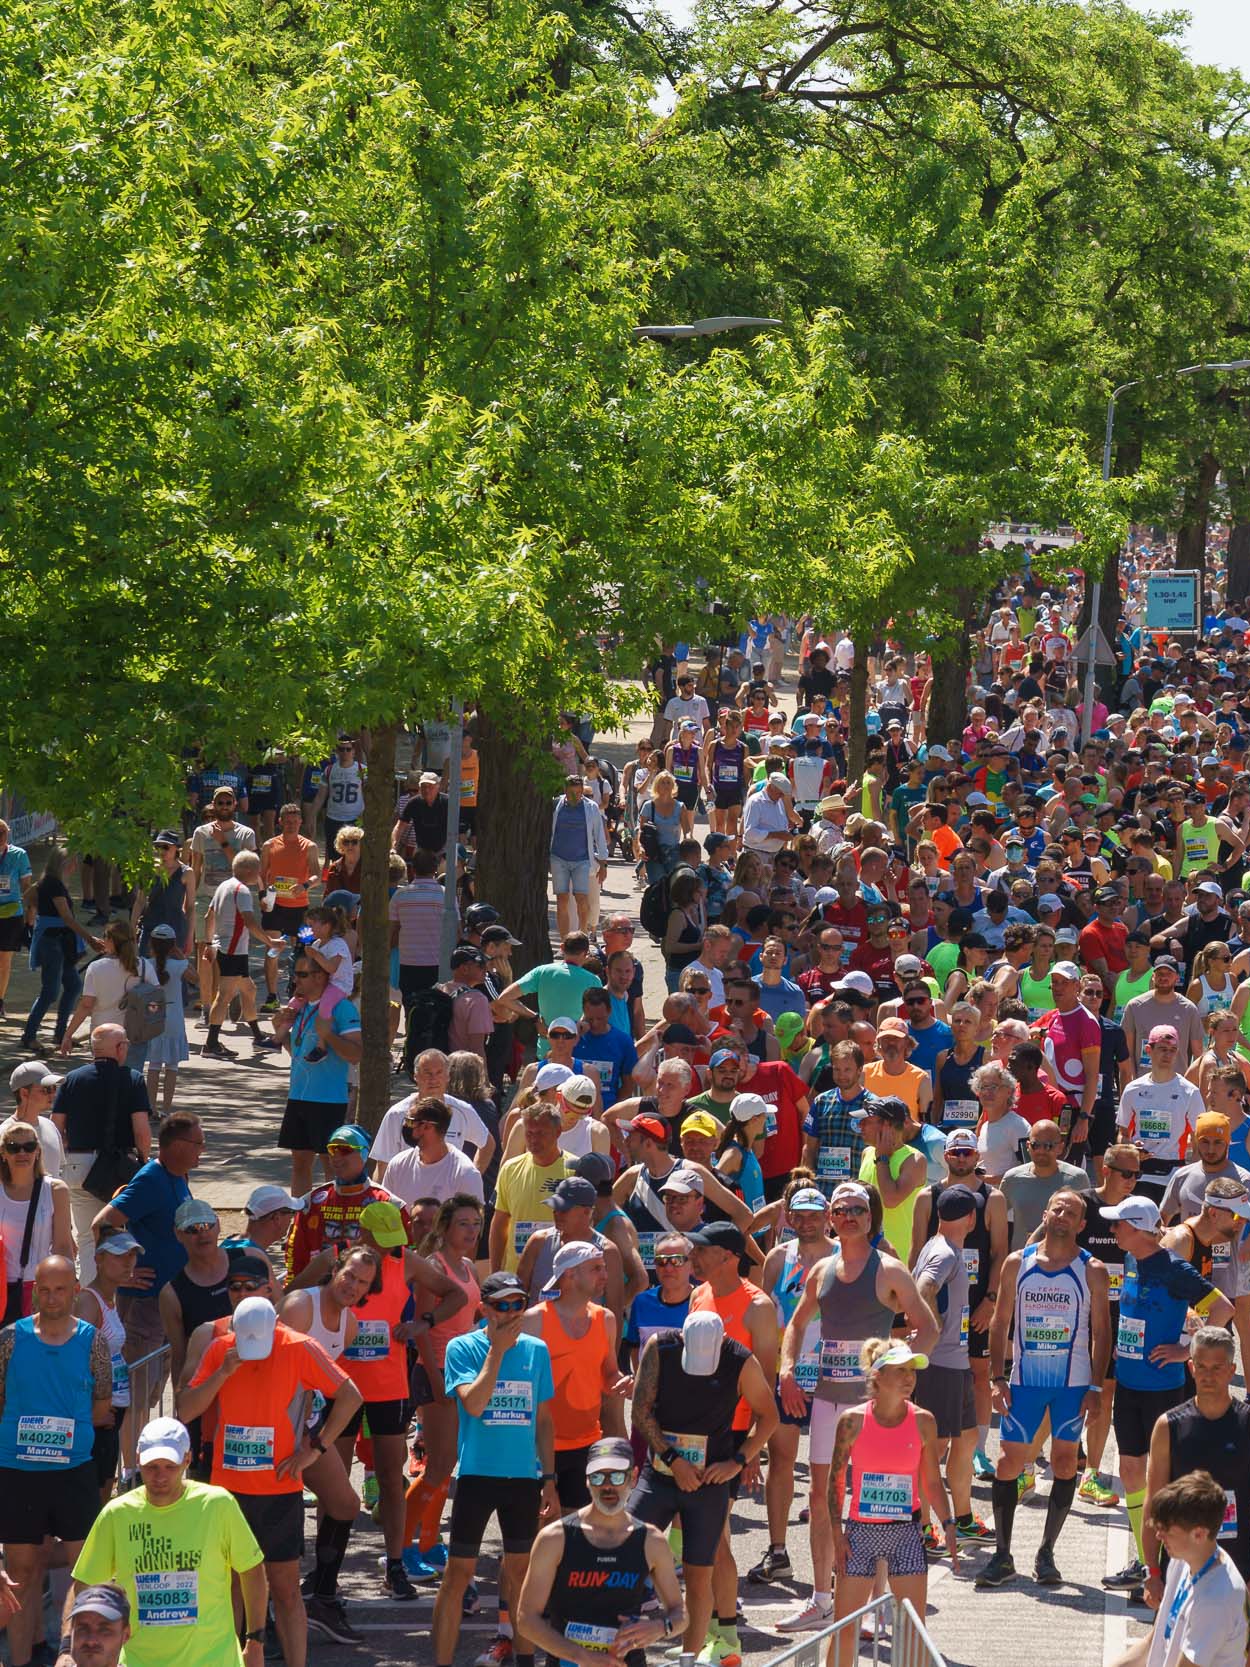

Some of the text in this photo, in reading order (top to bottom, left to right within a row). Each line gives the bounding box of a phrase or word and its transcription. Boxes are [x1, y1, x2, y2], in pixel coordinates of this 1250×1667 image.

[332, 783, 359, 804] 36
[1025, 1291, 1071, 1305] ERDINGER
[1025, 1330, 1064, 1341] M45987
[831, 1369, 853, 1377] Chris
[492, 1411, 526, 1419] Markus
[20, 1432, 66, 1445] M40229
[26, 1446, 63, 1456] Markus
[237, 1457, 257, 1465] Erik
[870, 1504, 903, 1514] Miriam
[129, 1522, 152, 1541] WE
[143, 1536, 172, 1554] ARE
[135, 1550, 202, 1573] RUNNERS
[137, 1582, 171, 1590] VENLOOP
[138, 1591, 190, 1606] M45083
[146, 1609, 189, 1620] Andrew
